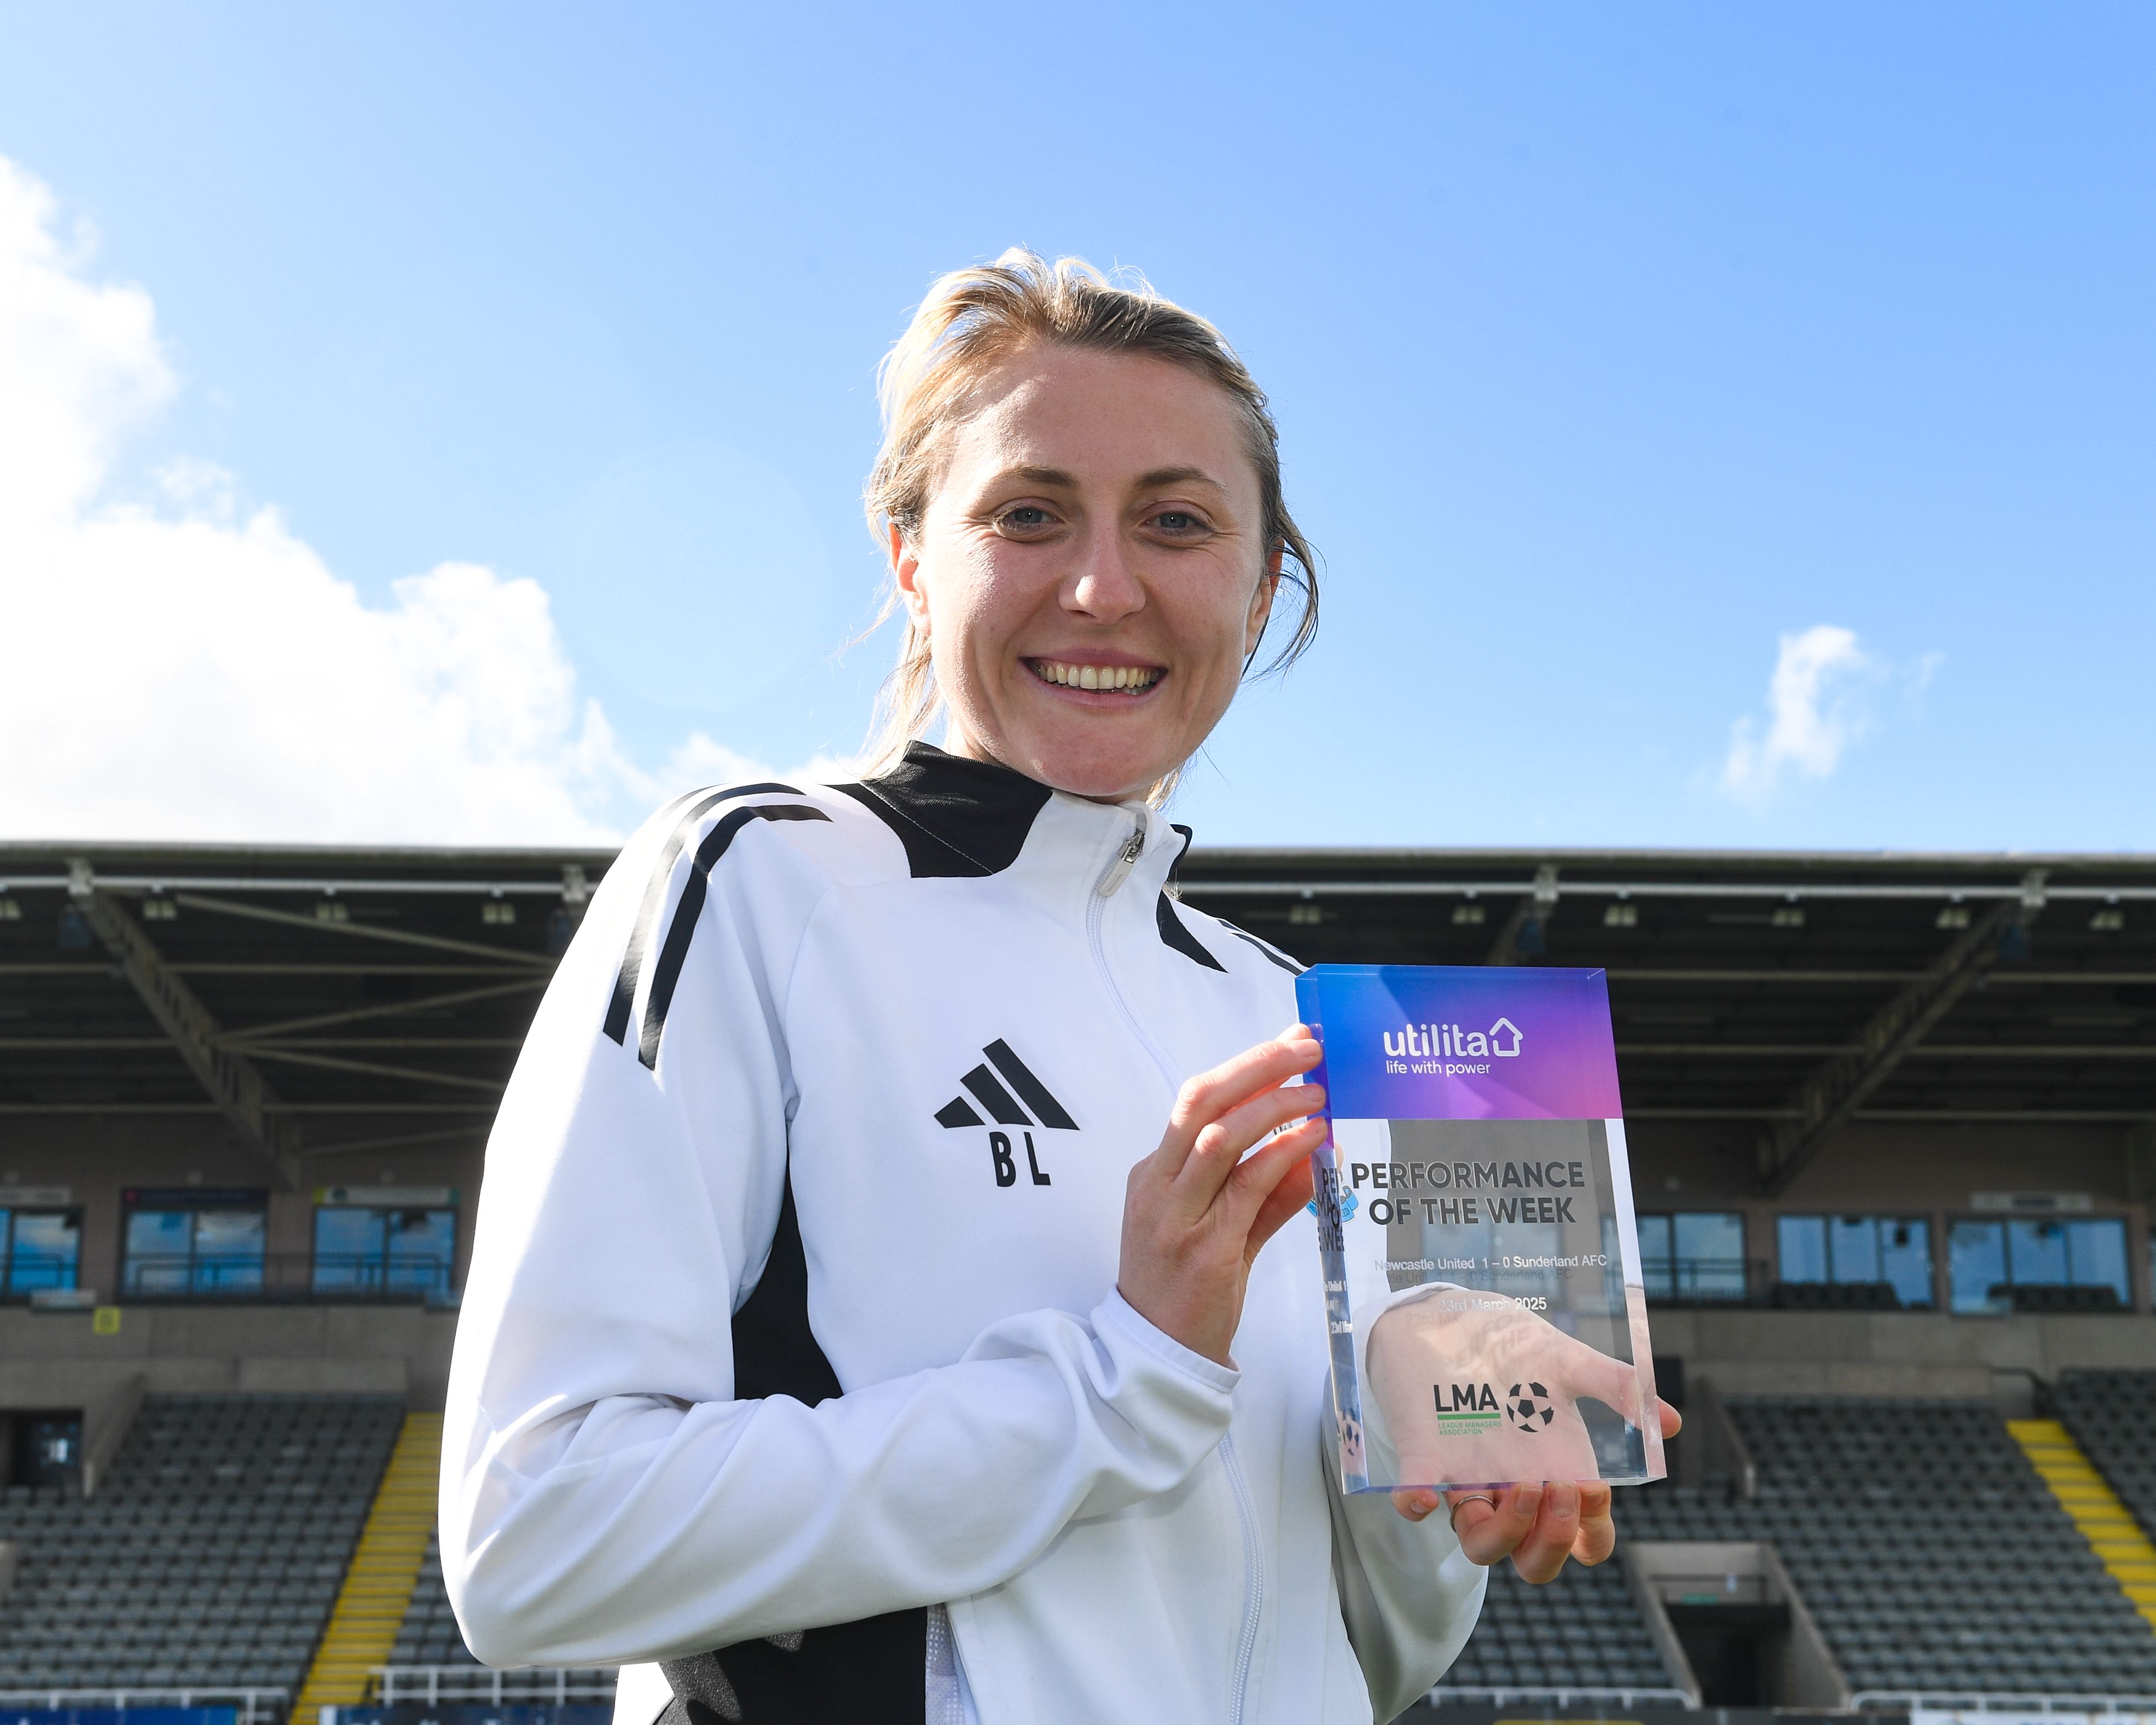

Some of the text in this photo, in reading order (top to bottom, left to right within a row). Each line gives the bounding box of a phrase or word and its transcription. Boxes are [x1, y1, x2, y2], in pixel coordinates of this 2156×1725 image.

[1383, 1023, 1489, 1057] utilita
[1386, 1060, 1491, 1077] life with power
[1351, 1161, 1585, 1189] PERFORMANCE
[1369, 1198, 1412, 1225] OF
[1419, 1197, 1480, 1225] THE
[1485, 1197, 1577, 1224] WEEK
[1375, 1258, 1434, 1271] Newcastle
[1438, 1258, 1475, 1270] United
[1482, 1257, 1488, 1269] 1
[1503, 1256, 1510, 1268] 0
[1514, 1255, 1579, 1267] Sunderland
[1582, 1254, 1607, 1266] AFC
[1439, 1297, 1548, 1312] 23rd March 2025
[1433, 1383, 1500, 1412] LMA
